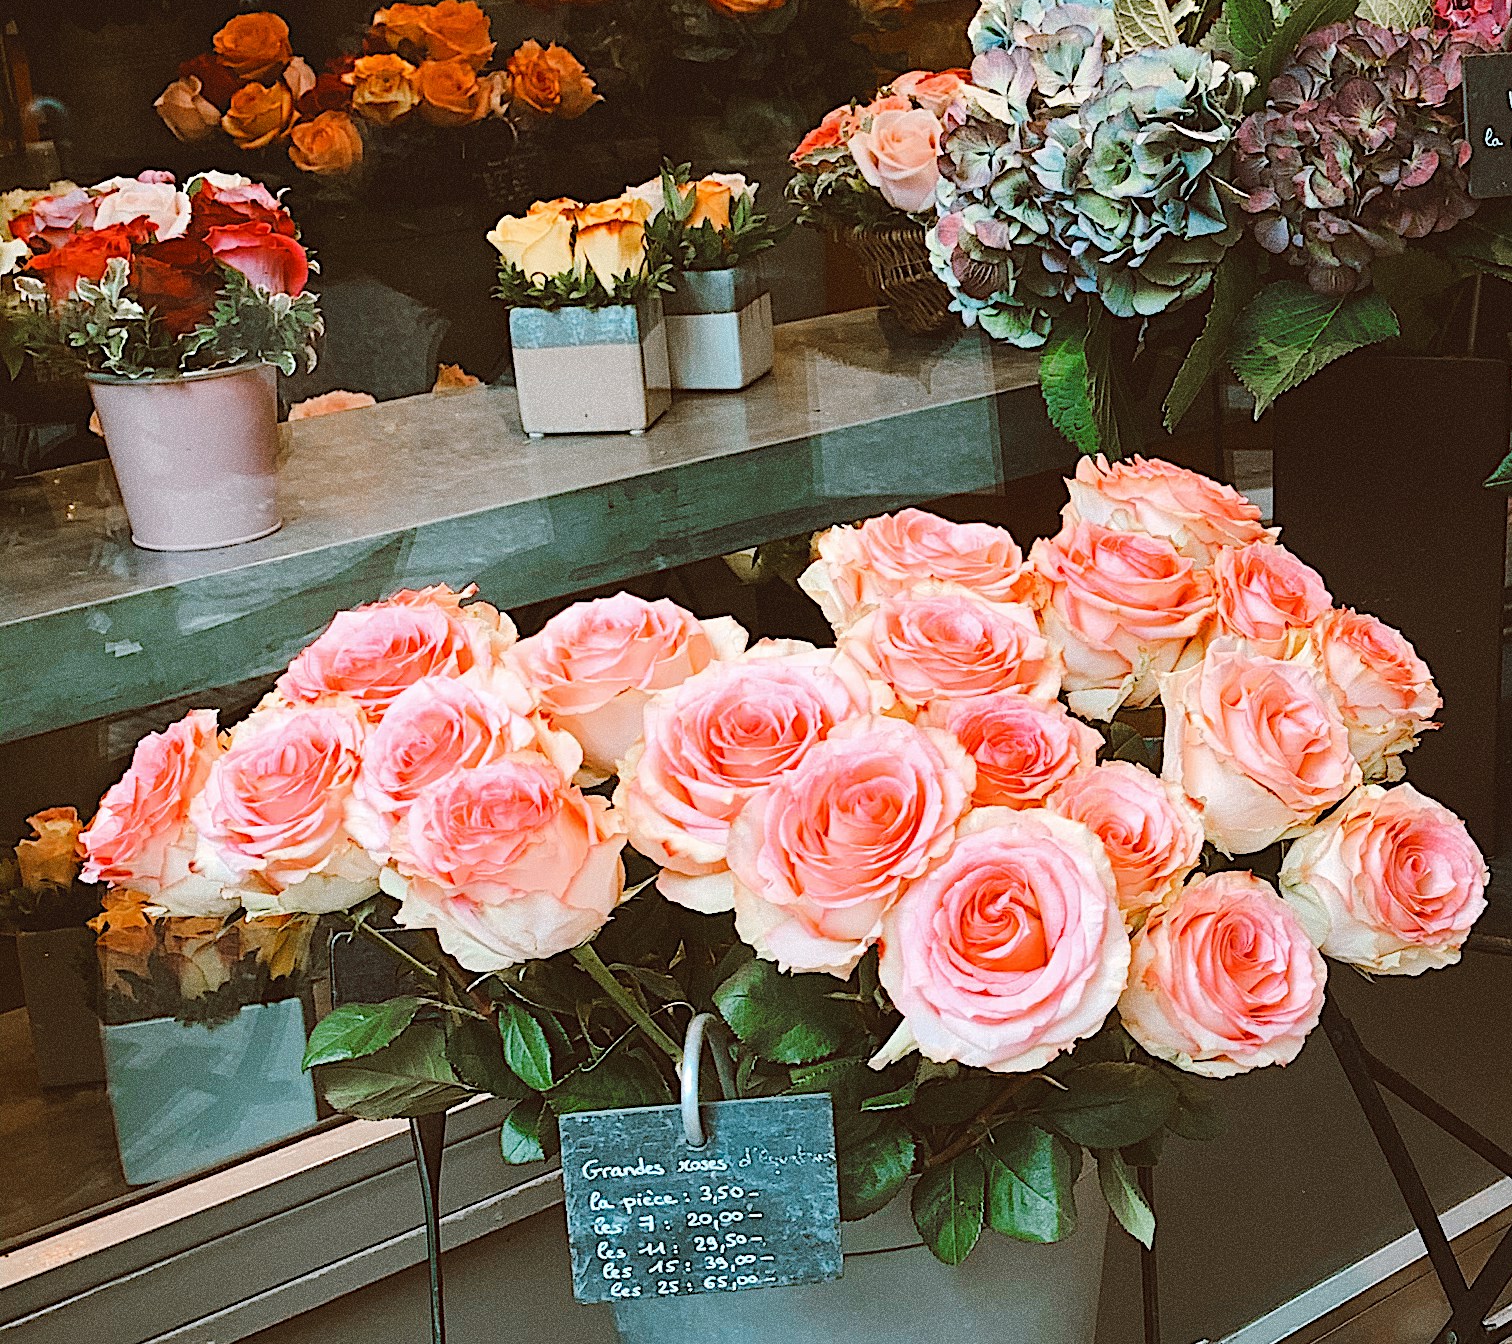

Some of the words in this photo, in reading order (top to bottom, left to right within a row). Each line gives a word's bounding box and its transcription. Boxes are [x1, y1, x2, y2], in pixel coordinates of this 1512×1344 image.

[1484, 128, 1504, 147] la
[582, 1157, 665, 1180] Grandes
[677, 1156, 728, 1174] roses
[589, 1190, 615, 1212] la
[592, 1217, 623, 1235] les
[596, 1241, 627, 1260] les
[602, 1263, 632, 1280] les
[610, 1283, 642, 1298] les
